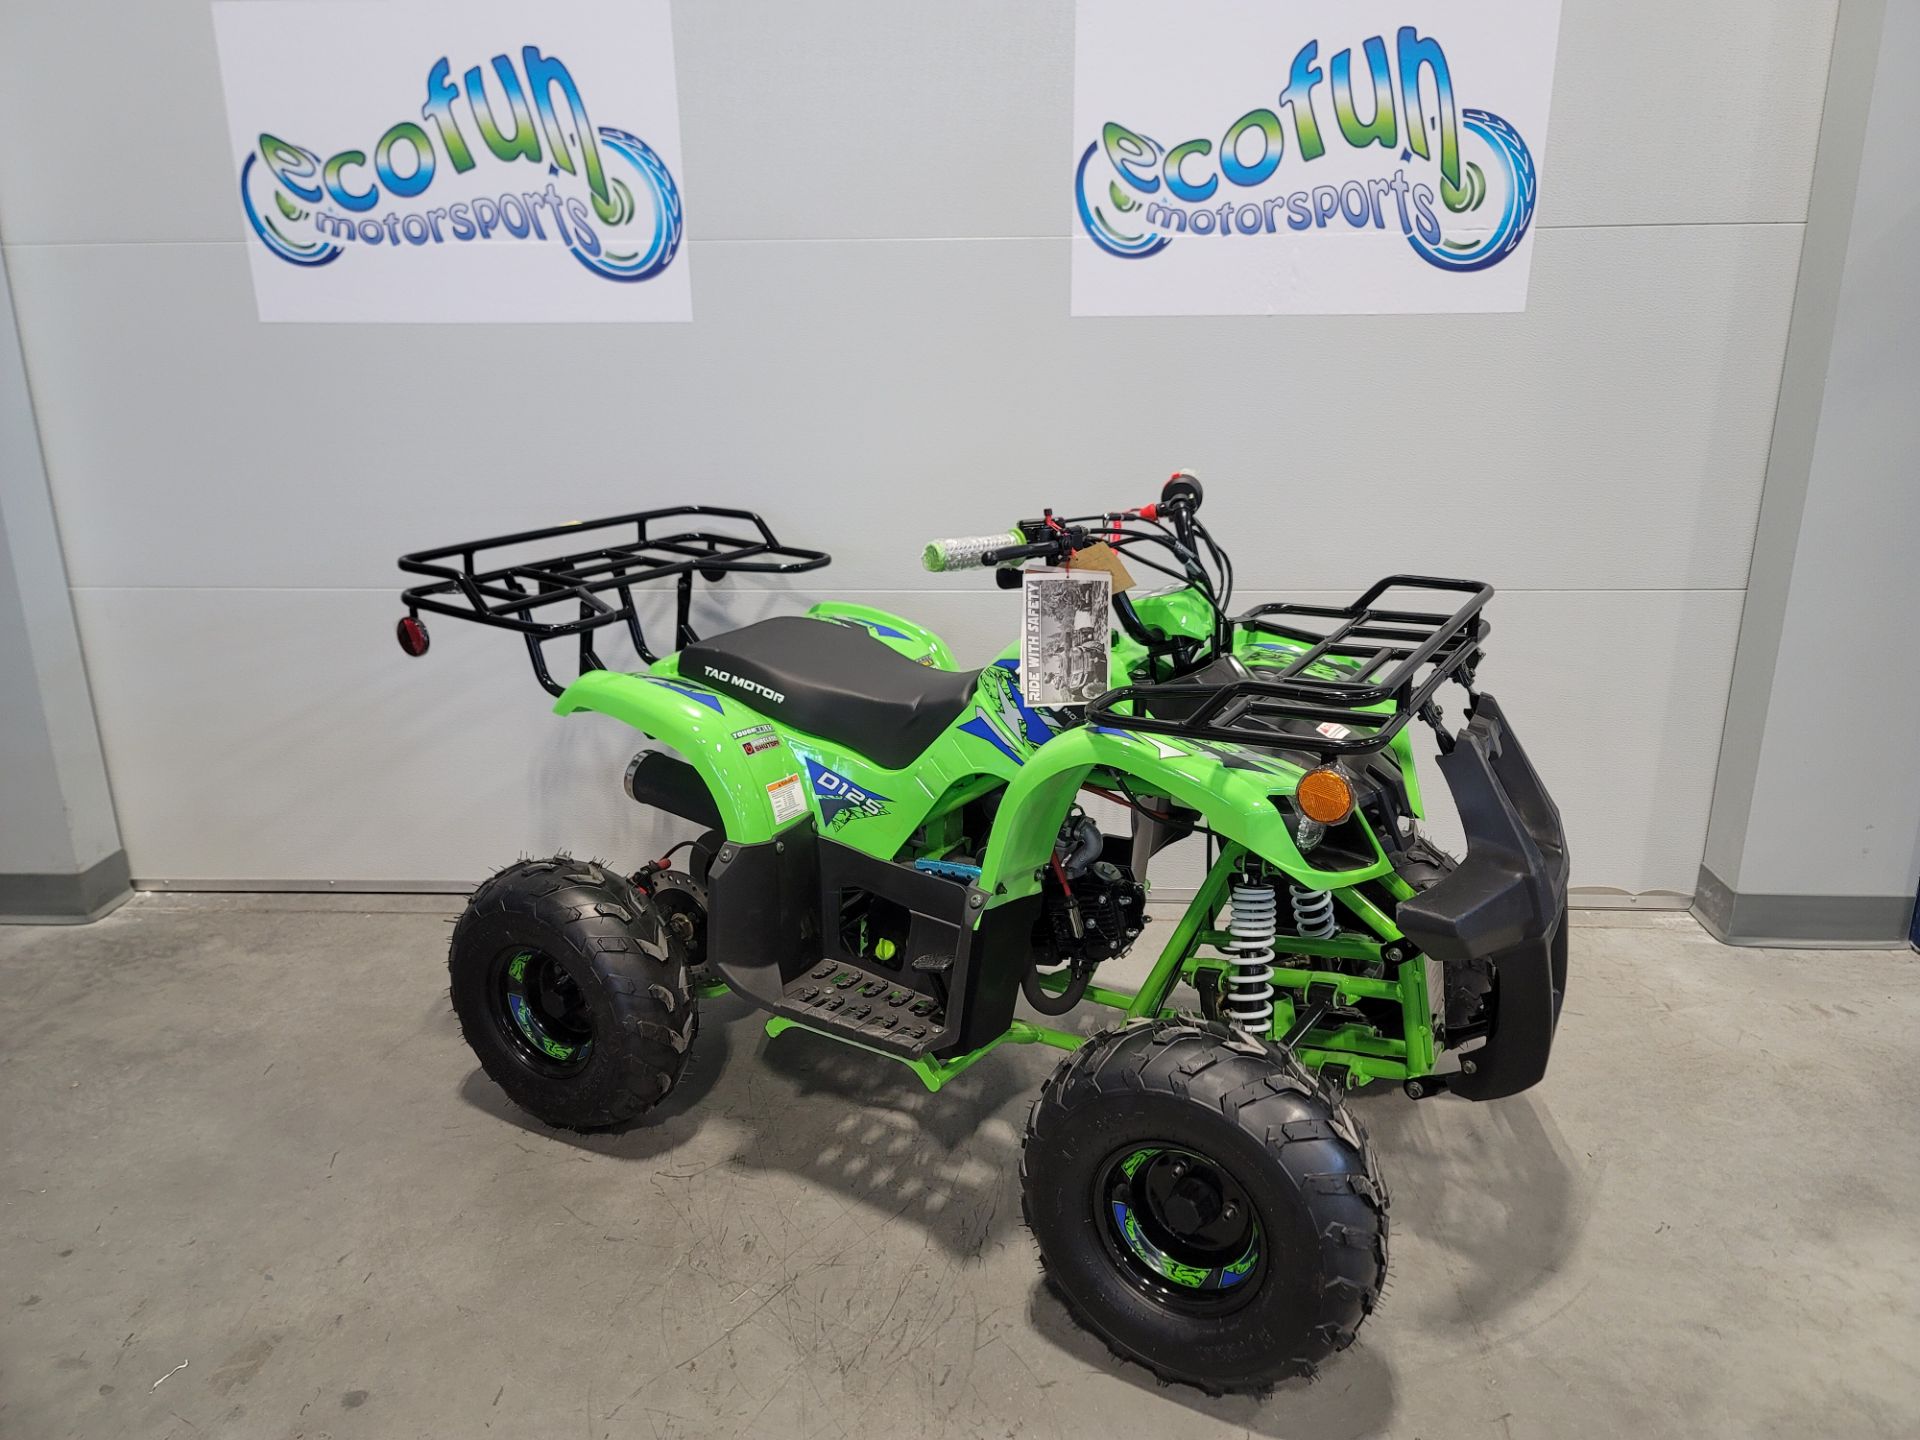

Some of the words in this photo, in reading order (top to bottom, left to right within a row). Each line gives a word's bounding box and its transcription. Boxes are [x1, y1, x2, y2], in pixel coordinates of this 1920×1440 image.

[259, 45, 610, 205] ecofun
[1102, 26, 1461, 191] ecofun
[315, 183, 602, 258] motorsports
[1146, 169, 1441, 246] motorsports
[1027, 583, 1040, 633] SAFETY
[1027, 635, 1040, 668] WITH
[704, 665, 730, 683] TAO
[731, 675, 785, 704] MOTOR
[1028, 672, 1041, 702] RIDE
[1062, 707, 1079, 721] MO
[816, 771, 885, 815] D125
